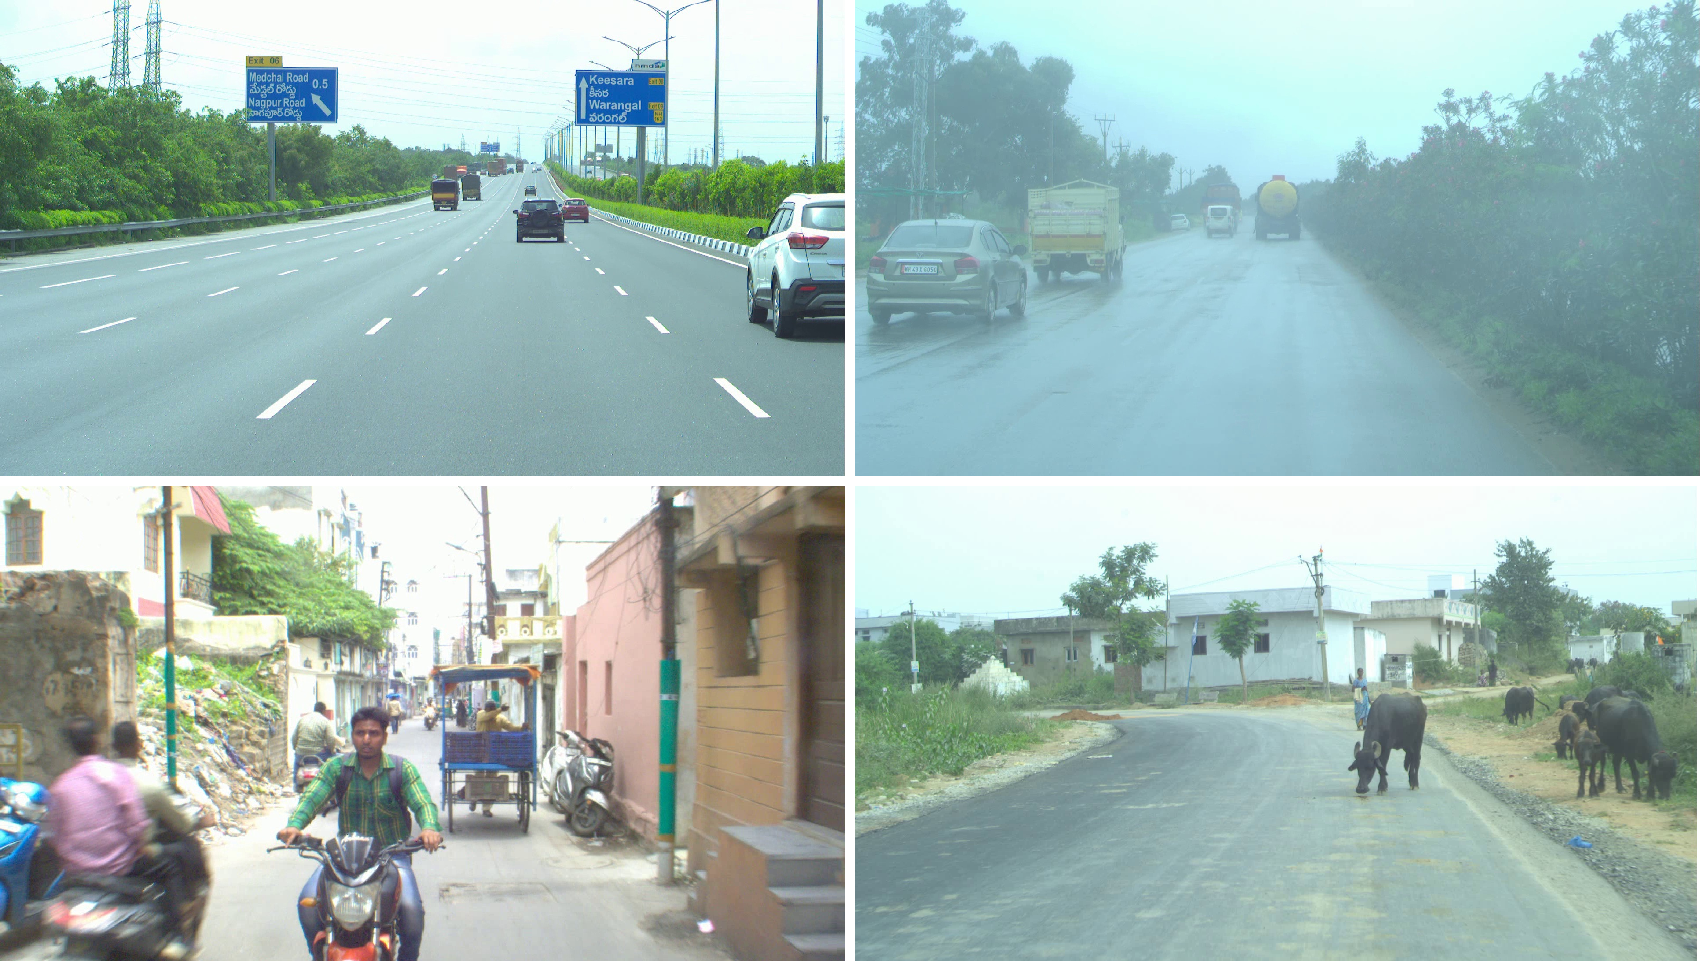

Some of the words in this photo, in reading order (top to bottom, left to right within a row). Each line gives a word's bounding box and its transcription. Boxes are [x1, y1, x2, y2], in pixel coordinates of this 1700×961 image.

[248, 56, 264, 64] Exit
[250, 72, 284, 82] Medchal
[286, 72, 308, 82] Road
[589, 75, 634, 86] Keesara
[312, 79, 328, 89] 0.5
[588, 86, 609, 98] కీసర
[248, 97, 282, 108] Nagpur
[283, 97, 306, 107] Road
[588, 100, 641, 112] Warangal
[588, 112, 627, 123] వరంగల్
